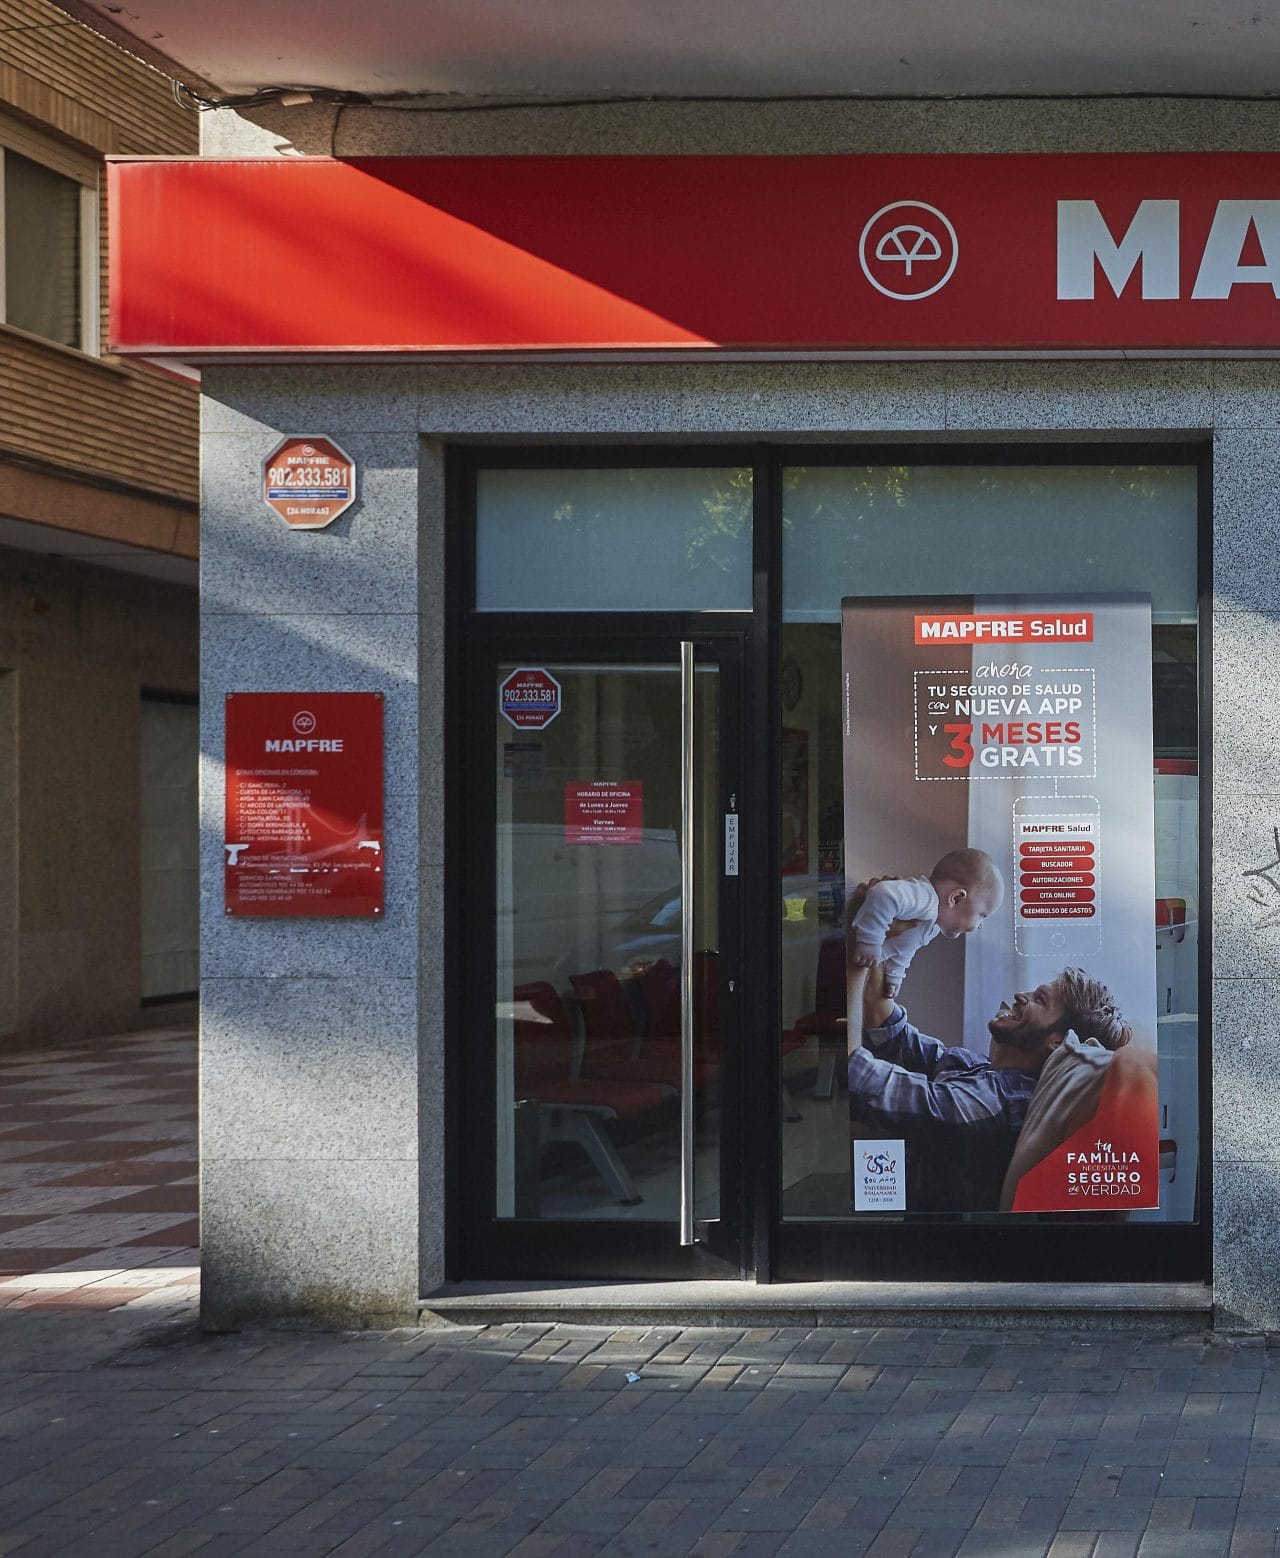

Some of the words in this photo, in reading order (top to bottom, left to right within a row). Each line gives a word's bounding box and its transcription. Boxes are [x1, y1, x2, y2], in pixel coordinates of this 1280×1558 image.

[287, 457, 329, 465] MAPFRE
[269, 467, 347, 486] 902.333.581
[921, 620, 1023, 638] MAPFRE
[1030, 619, 1086, 636] Salud
[975, 662, 1032, 679] ahora
[504, 689, 555, 702] 902.333.581
[927, 686, 945, 697] TU
[950, 685, 1007, 697] SEGURO
[1013, 685, 1030, 696] DE
[1035, 684, 1081, 696] SALUD
[927, 702, 950, 713] con
[955, 699, 1031, 716] NUEVA
[1038, 698, 1082, 714] APP
[265, 739, 344, 752] MAPFRE
[928, 725, 938, 736] Y
[942, 723, 974, 768] 3
[982, 722, 1080, 744] MESES
[980, 746, 1082, 767] GRATIS
[1022, 825, 1065, 833] MAPFRE
[1067, 824, 1090, 832] Salud
[728, 818, 736, 872] EMPUJAR
[1094, 1139, 1112, 1153] tu
[1067, 1152, 1140, 1164] FAMILIA
[1068, 1172, 1141, 1184] SEGURO
[1081, 1184, 1141, 1196] VERDAD
